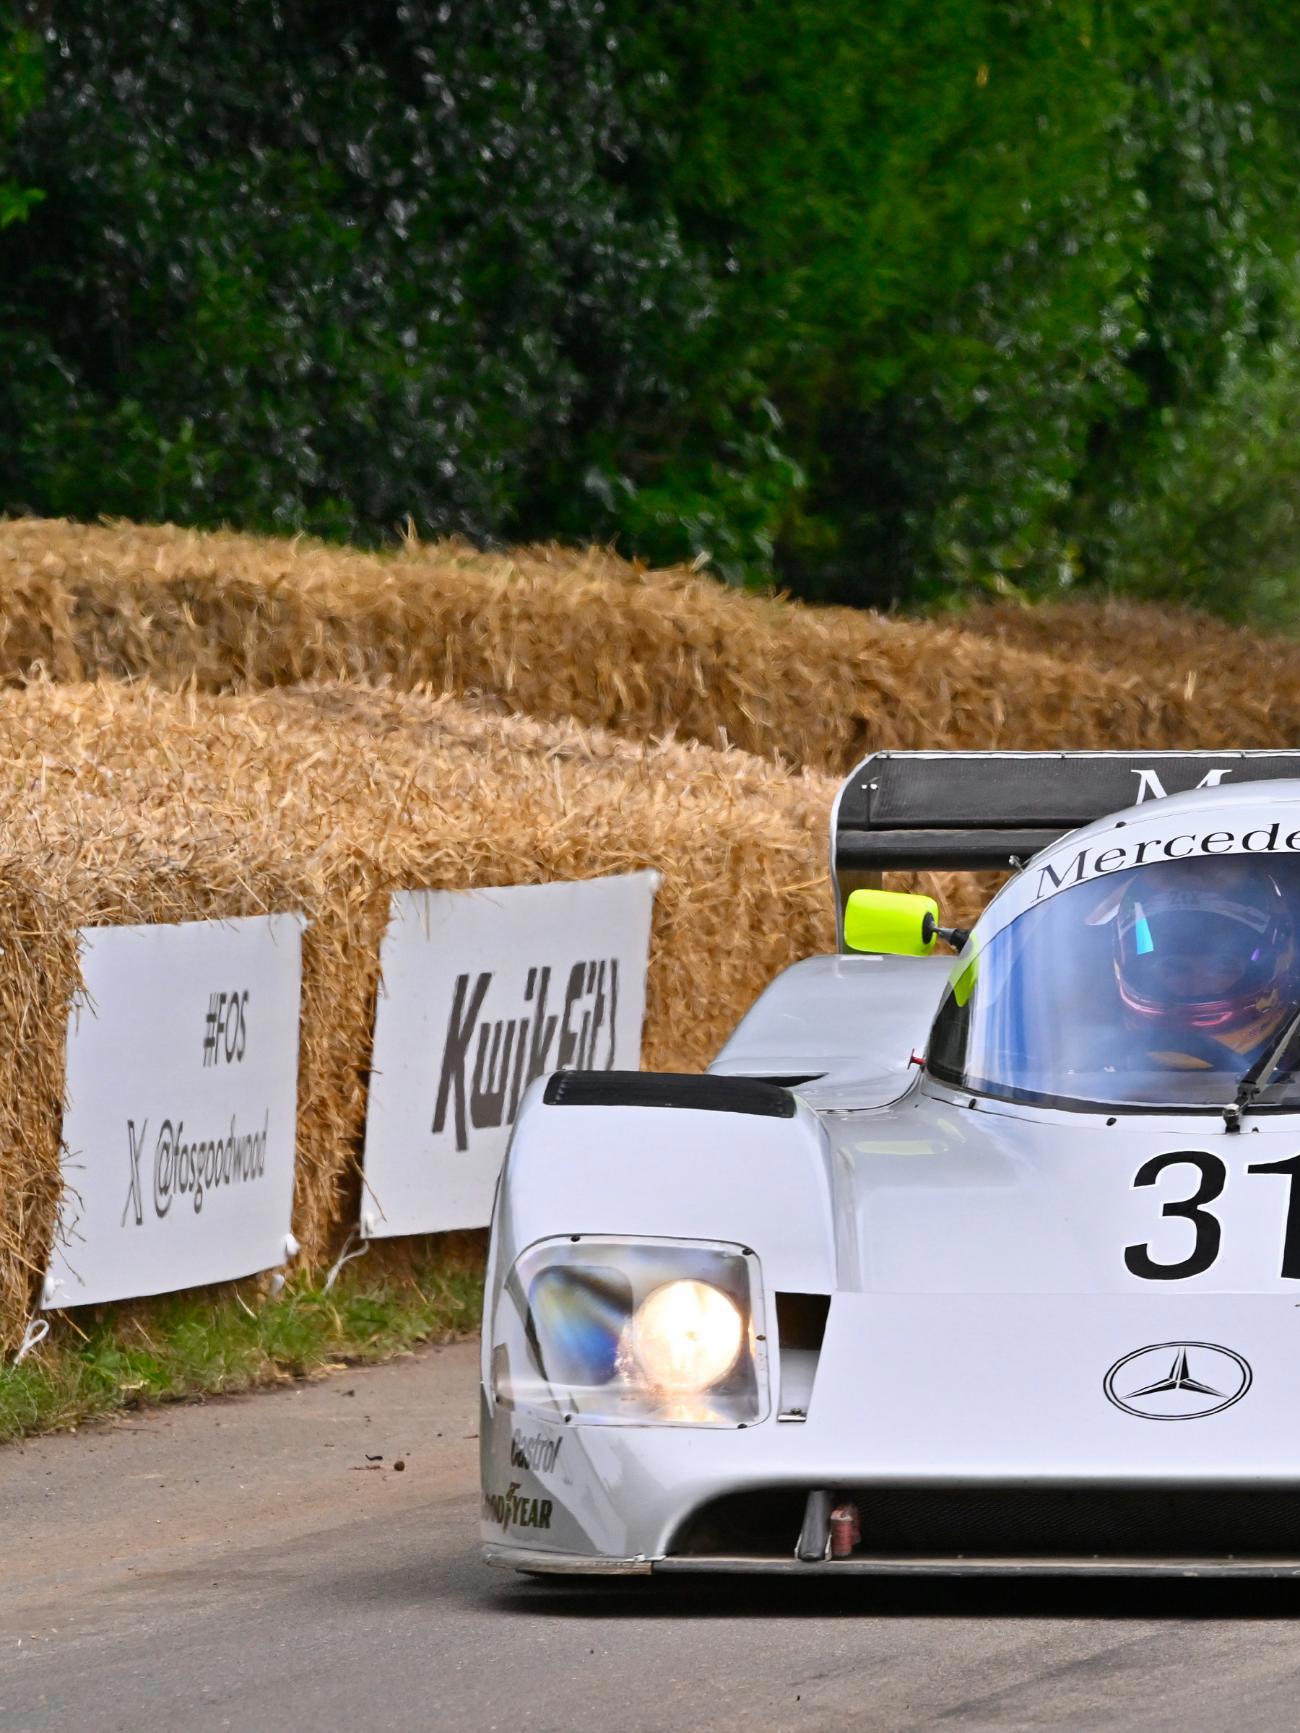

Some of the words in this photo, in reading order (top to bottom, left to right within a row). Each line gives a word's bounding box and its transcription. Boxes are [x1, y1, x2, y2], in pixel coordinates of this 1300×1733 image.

[203, 989, 249, 1067] #FOS
[154, 1107, 269, 1218] @fosgoodwood
[511, 1428, 563, 1473] Castrol
